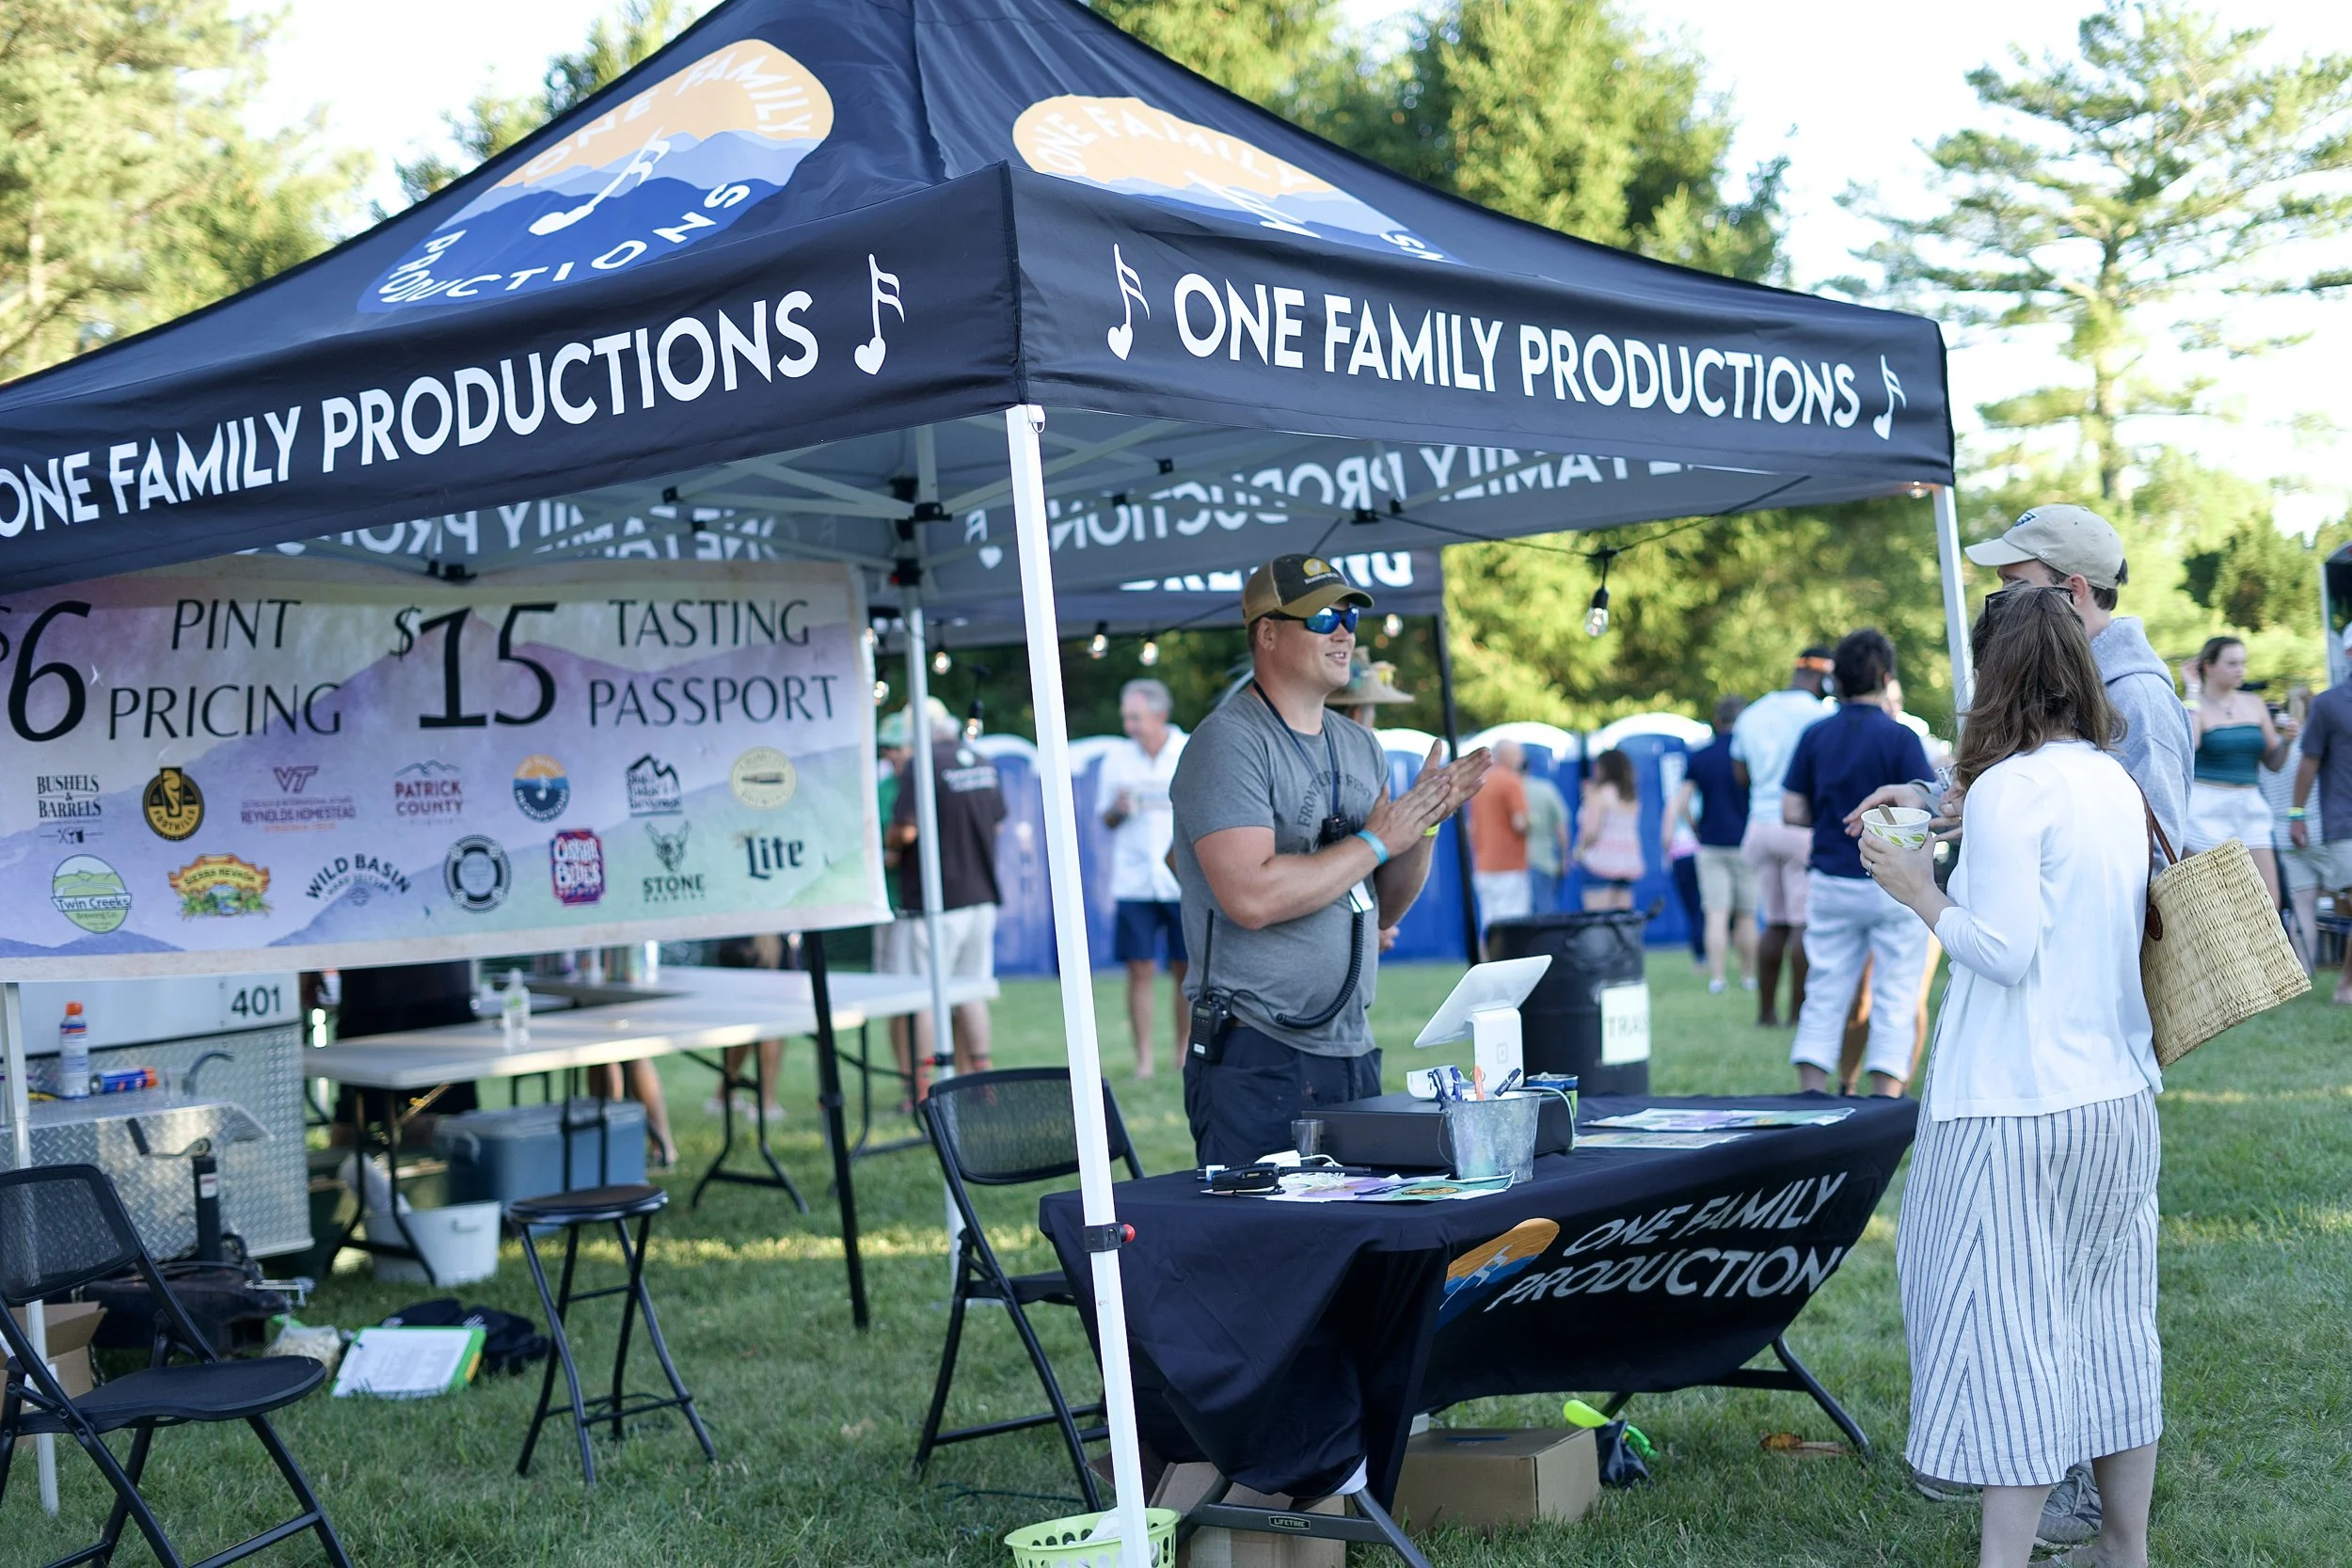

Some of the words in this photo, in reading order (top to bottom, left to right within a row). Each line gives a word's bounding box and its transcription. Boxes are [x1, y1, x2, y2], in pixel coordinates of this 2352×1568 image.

[526, 87, 660, 177] ONE
[675, 54, 815, 135] FAMILY
[1036, 112, 1099, 176] ONE
[1082, 105, 1313, 189] FAMILY
[378, 182, 751, 303] PRODUCTIONS
[1172, 272, 1306, 370] ONE
[1323, 293, 1504, 392] FAMILY
[1518, 324, 1862, 429] PRODUCTIONS
[0, 450, 99, 537] ONE
[108, 405, 301, 515] FAMILY
[321, 290, 819, 473] PRODUCTIONS
[171, 598, 302, 651] PINT
[607, 598, 810, 648] TASTING
[387, 600, 559, 730] $15
[108, 682, 342, 741] PRICING
[587, 674, 838, 728] PASSPORT
[37, 773, 100, 794] BUSHELS
[65, 791, 73, 800] &
[272, 765, 319, 794] VT
[394, 780, 462, 798] PATRICK
[39, 799, 102, 818] BARRELS
[395, 800, 464, 816] COUNTY
[305, 857, 349, 899] WILD
[355, 853, 412, 895] BASIN
[745, 836, 804, 880] Lite
[58, 897, 87, 910] Twin
[89, 895, 130, 908] Creeks
[642, 874, 707, 895] STONE
[231, 985, 281, 1017] 401
[1563, 1204, 1693, 1258] ONE
[1672, 1171, 1850, 1241] FAMILY
[1274, 1518, 1306, 1528] LIFETIME
